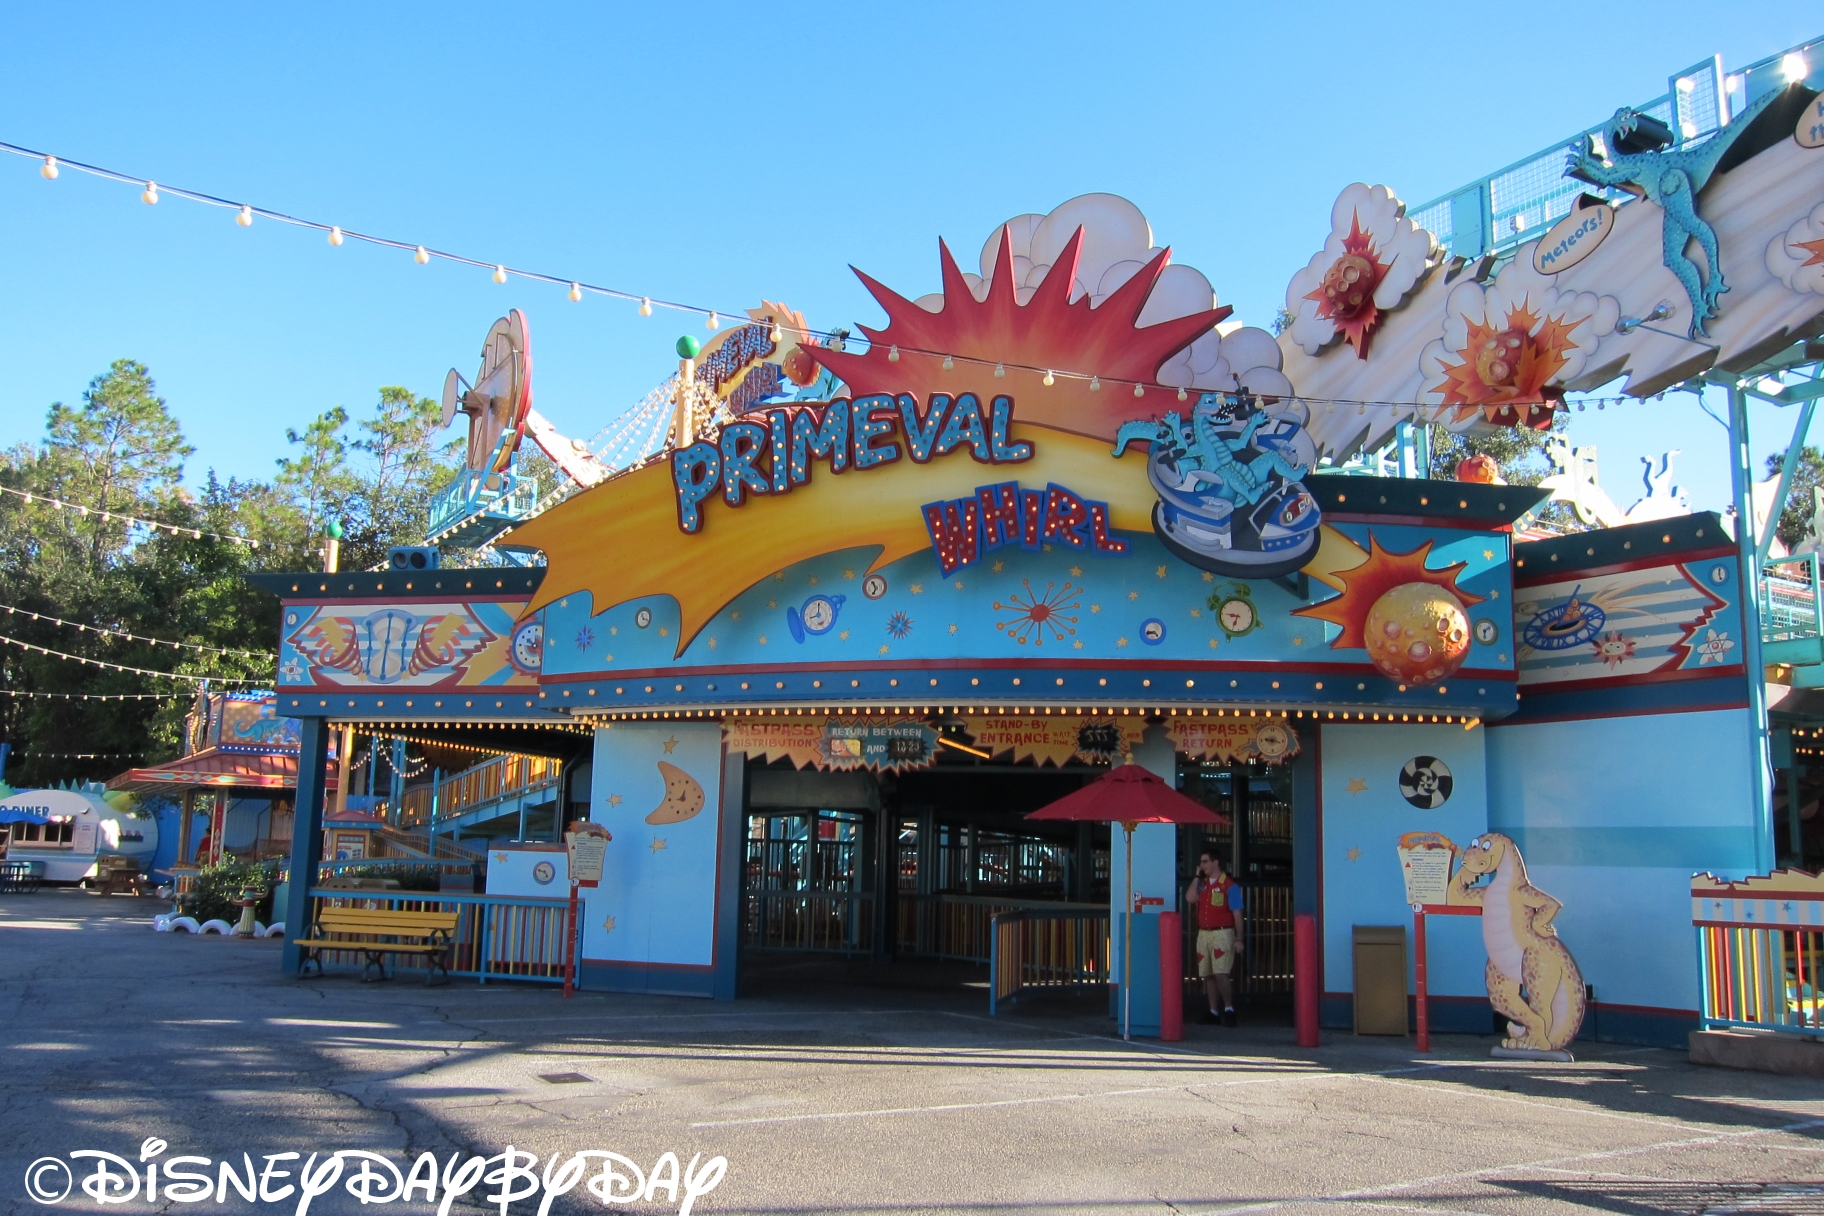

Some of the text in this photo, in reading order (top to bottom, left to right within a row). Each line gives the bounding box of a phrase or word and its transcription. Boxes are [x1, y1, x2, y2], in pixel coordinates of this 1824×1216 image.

[1541, 208, 1603, 269] Meteors!
[672, 392, 1035, 535] PRIMEVAL
[921, 481, 1130, 579] WHIRL
[733, 720, 815, 737] FASTPASS
[832, 728, 922, 737] RETURN BETWEEN
[985, 719, 1048, 732] STAND-BY
[1173, 720, 1249, 737] FASTPASS
[733, 738, 812, 748] DISTRIBUTION
[980, 732, 1050, 746] ENTRANCE
[1182, 738, 1232, 749] RETURN
[866, 744, 886, 754] AND
